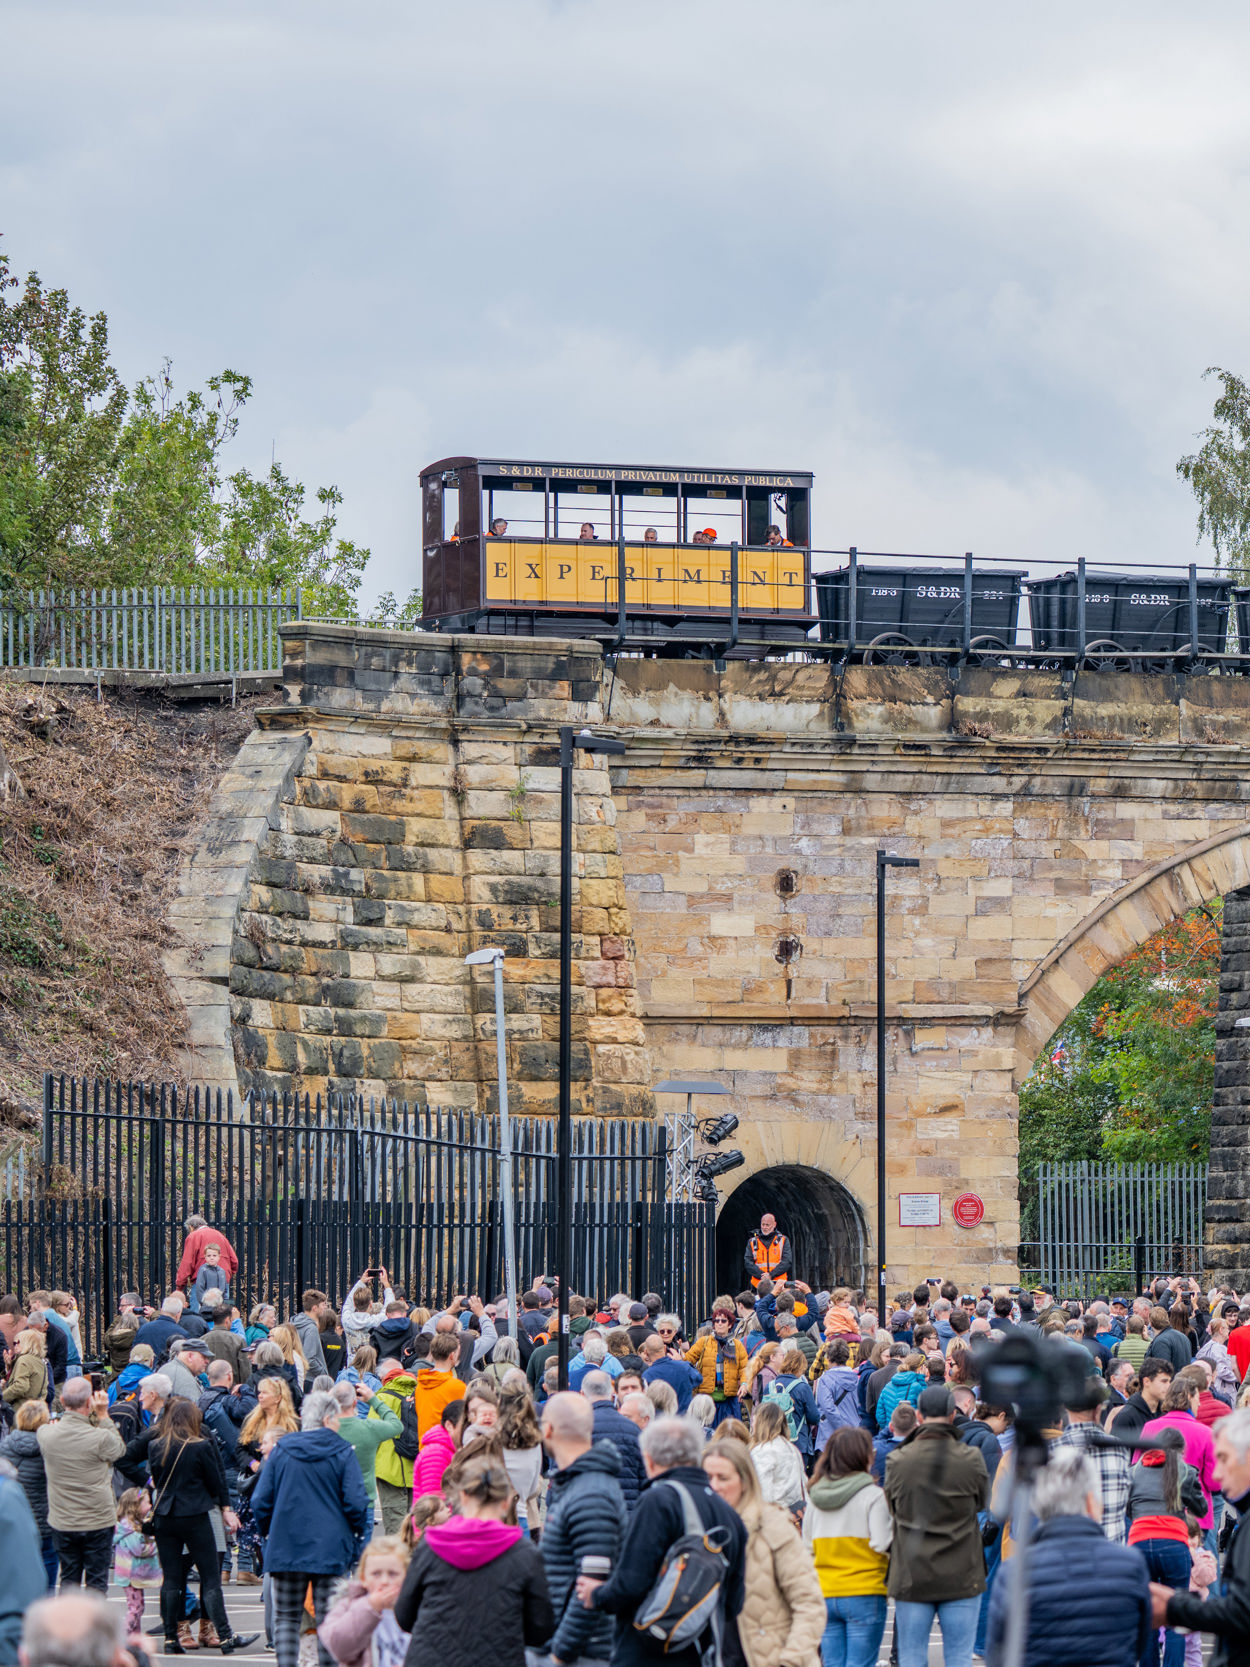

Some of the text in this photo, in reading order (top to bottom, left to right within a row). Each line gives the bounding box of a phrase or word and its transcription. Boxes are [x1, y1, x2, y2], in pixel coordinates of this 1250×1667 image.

[551, 468, 616, 479] PERICULUM
[621, 470, 680, 481] PRIVATUM
[684, 473, 739, 484] UTILITAS
[744, 475, 794, 487] PUBLICA
[493, 562, 798, 587] EXPERIMENT
